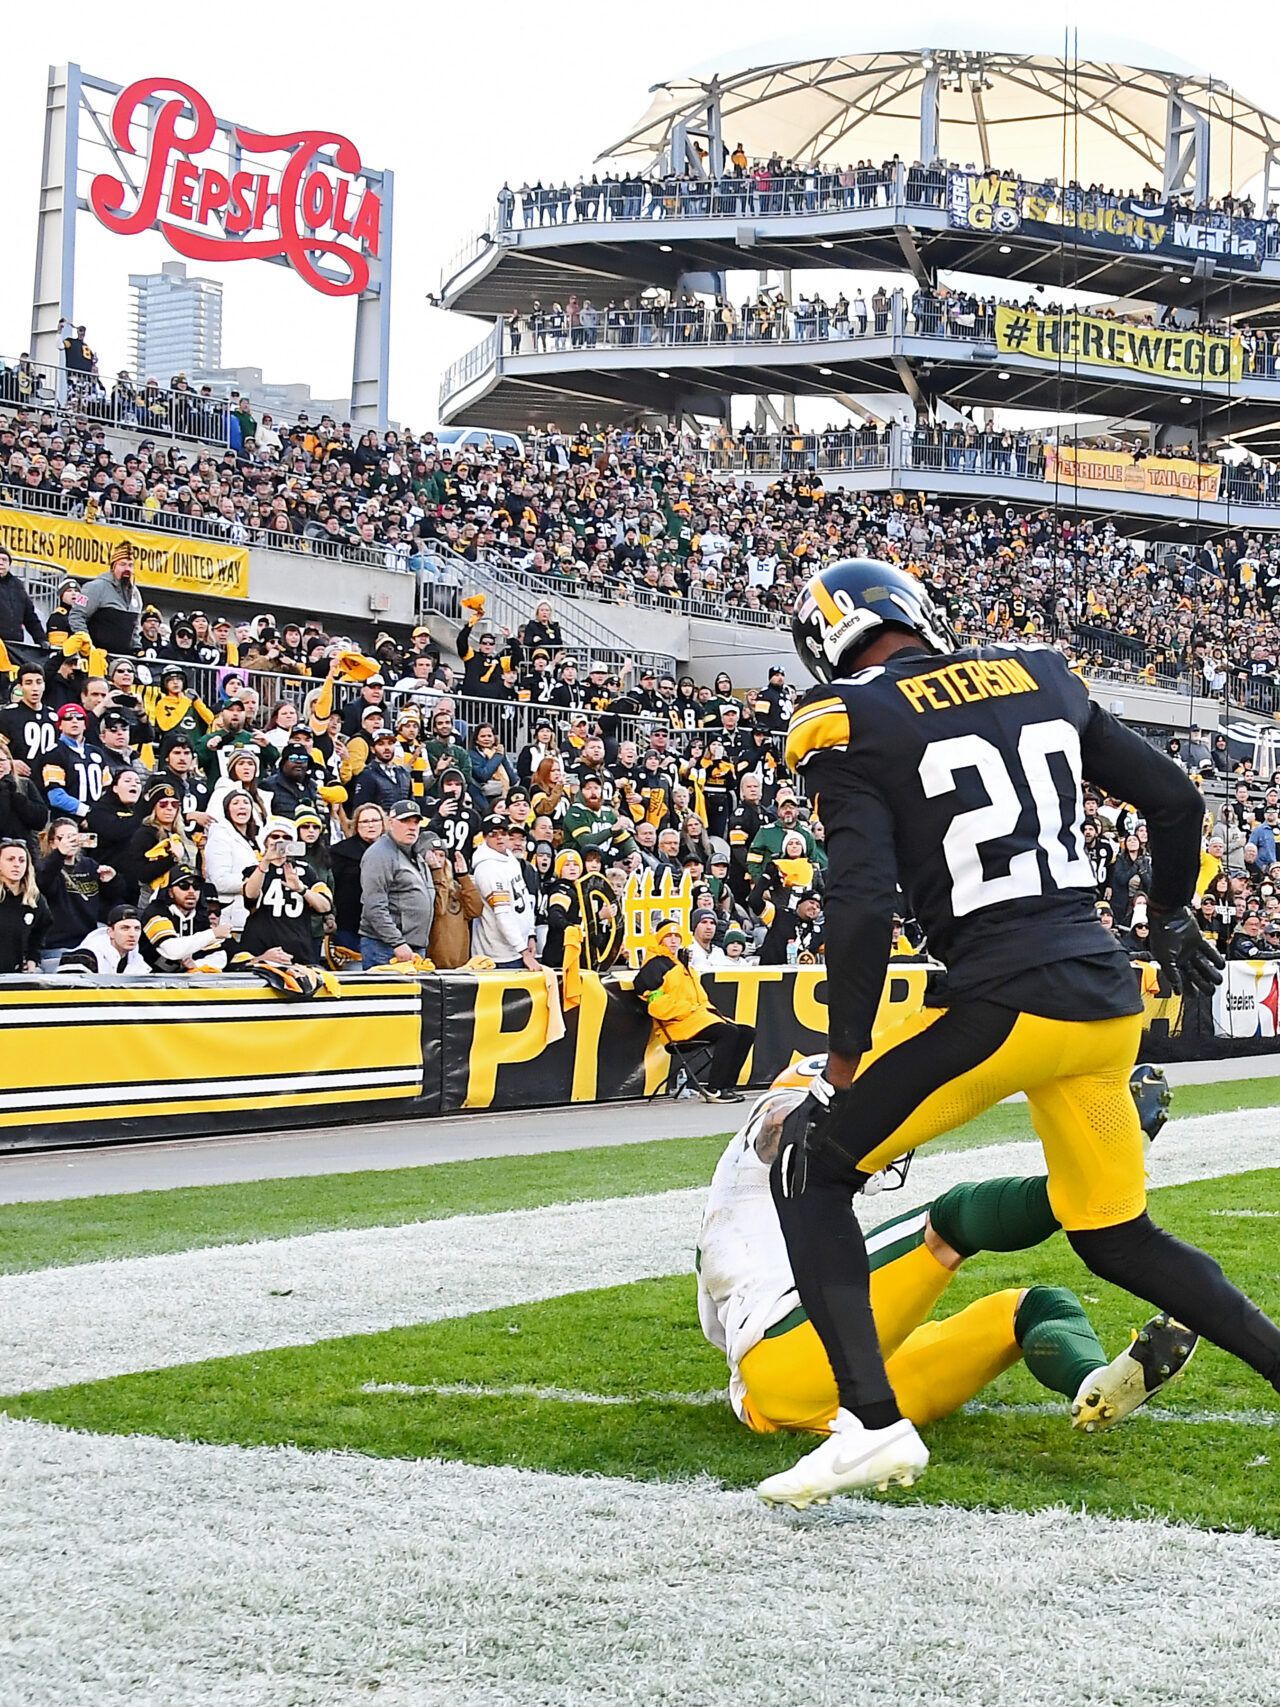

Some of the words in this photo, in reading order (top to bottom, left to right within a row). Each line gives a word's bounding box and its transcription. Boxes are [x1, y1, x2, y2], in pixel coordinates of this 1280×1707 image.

[967, 176, 1019, 208] WE
[1002, 314, 1230, 377] #HEREWEGO
[1052, 457, 1123, 482] TERRIBLE
[1148, 469, 1217, 493] TAILGATE
[0, 524, 56, 557] TEELERS
[58, 533, 113, 567] PROUDLY
[172, 552, 214, 581] UNITED
[215, 557, 241, 585] WAY
[829, 615, 860, 644] Steelers
[896, 657, 1040, 714] PETERSON
[24, 720, 57, 760] 90
[75, 763, 102, 802] 10
[444, 820, 469, 851] 39
[917, 718, 1099, 918] 20
[1226, 989, 1255, 1012] Steelers
